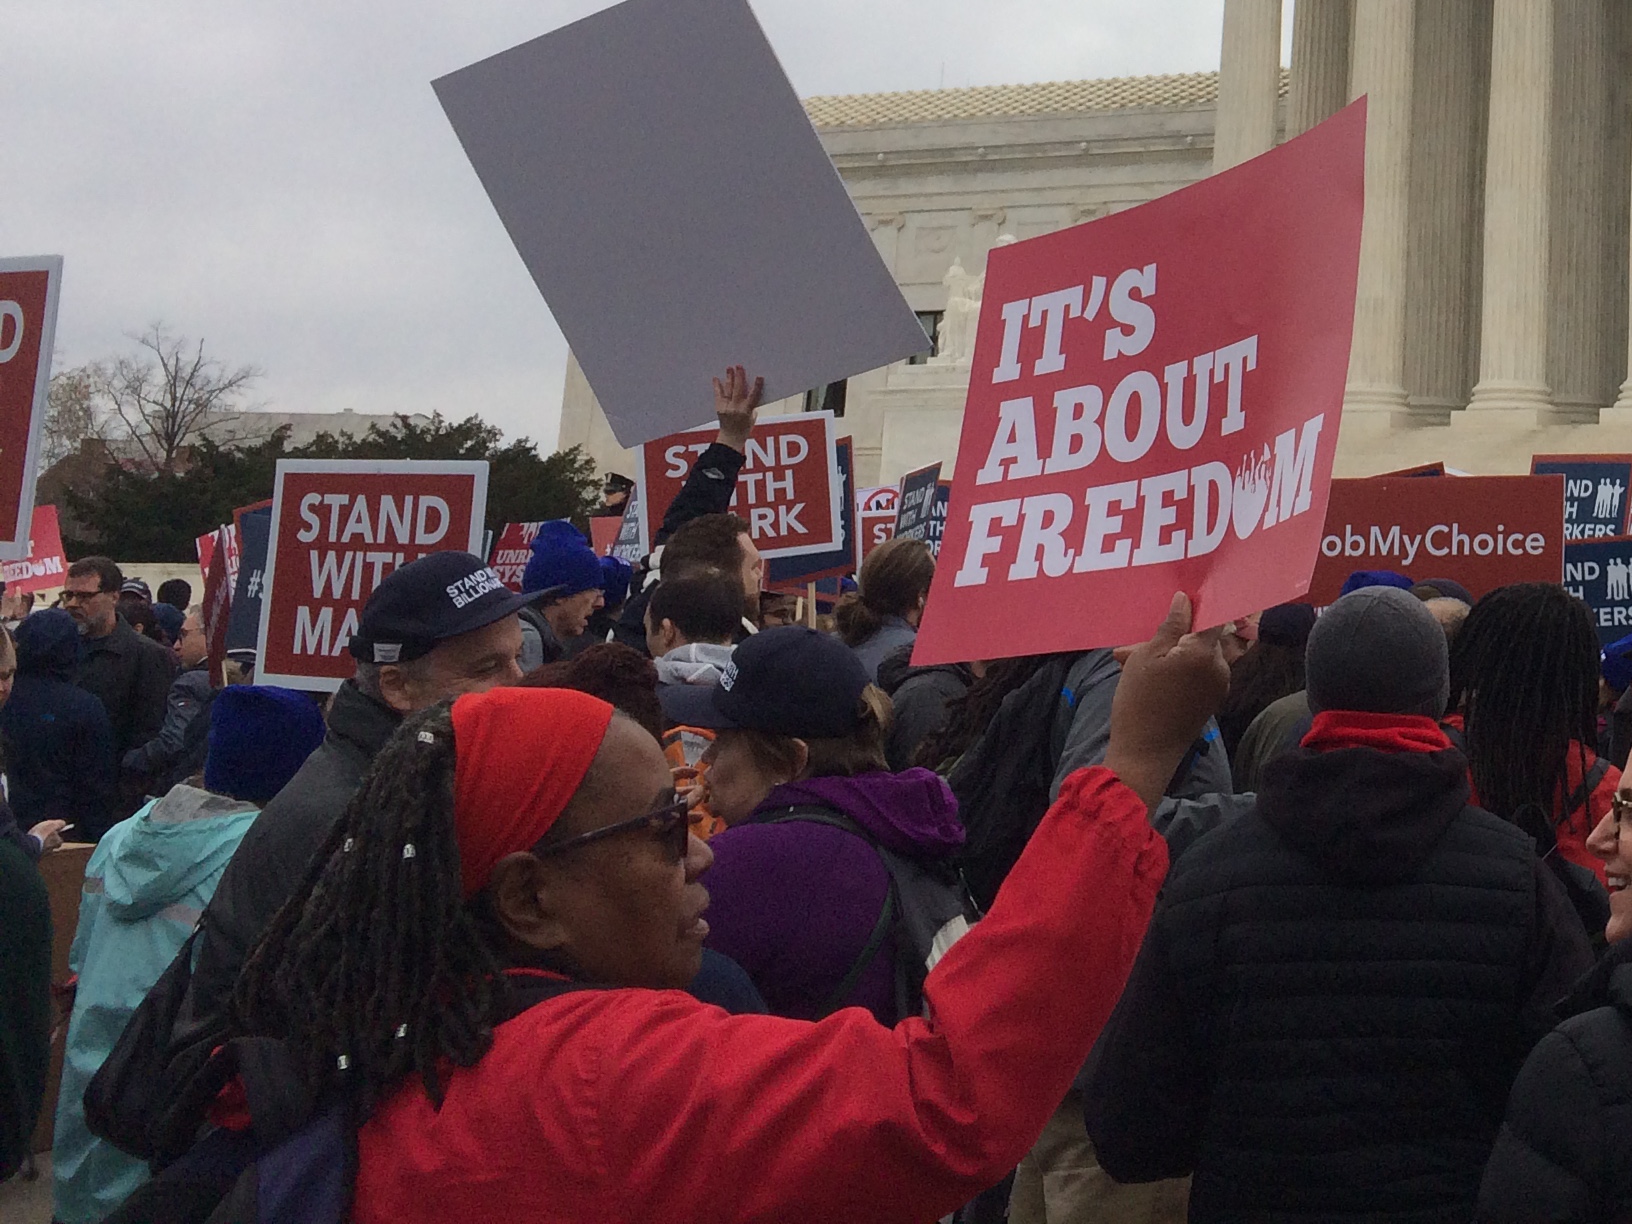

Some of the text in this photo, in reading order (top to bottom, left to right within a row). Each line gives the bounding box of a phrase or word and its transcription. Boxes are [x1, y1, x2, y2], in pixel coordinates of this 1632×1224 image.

[992, 263, 1157, 384] IT'S
[975, 335, 1258, 485] ABOUT
[664, 434, 809, 478] STND
[297, 492, 450, 545] STAND
[749, 503, 809, 540] RK
[953, 413, 1324, 587] FREEDOM
[1321, 523, 1546, 566] obMyChoice
[309, 550, 427, 600] WIT
[446, 569, 487, 598] STAND
